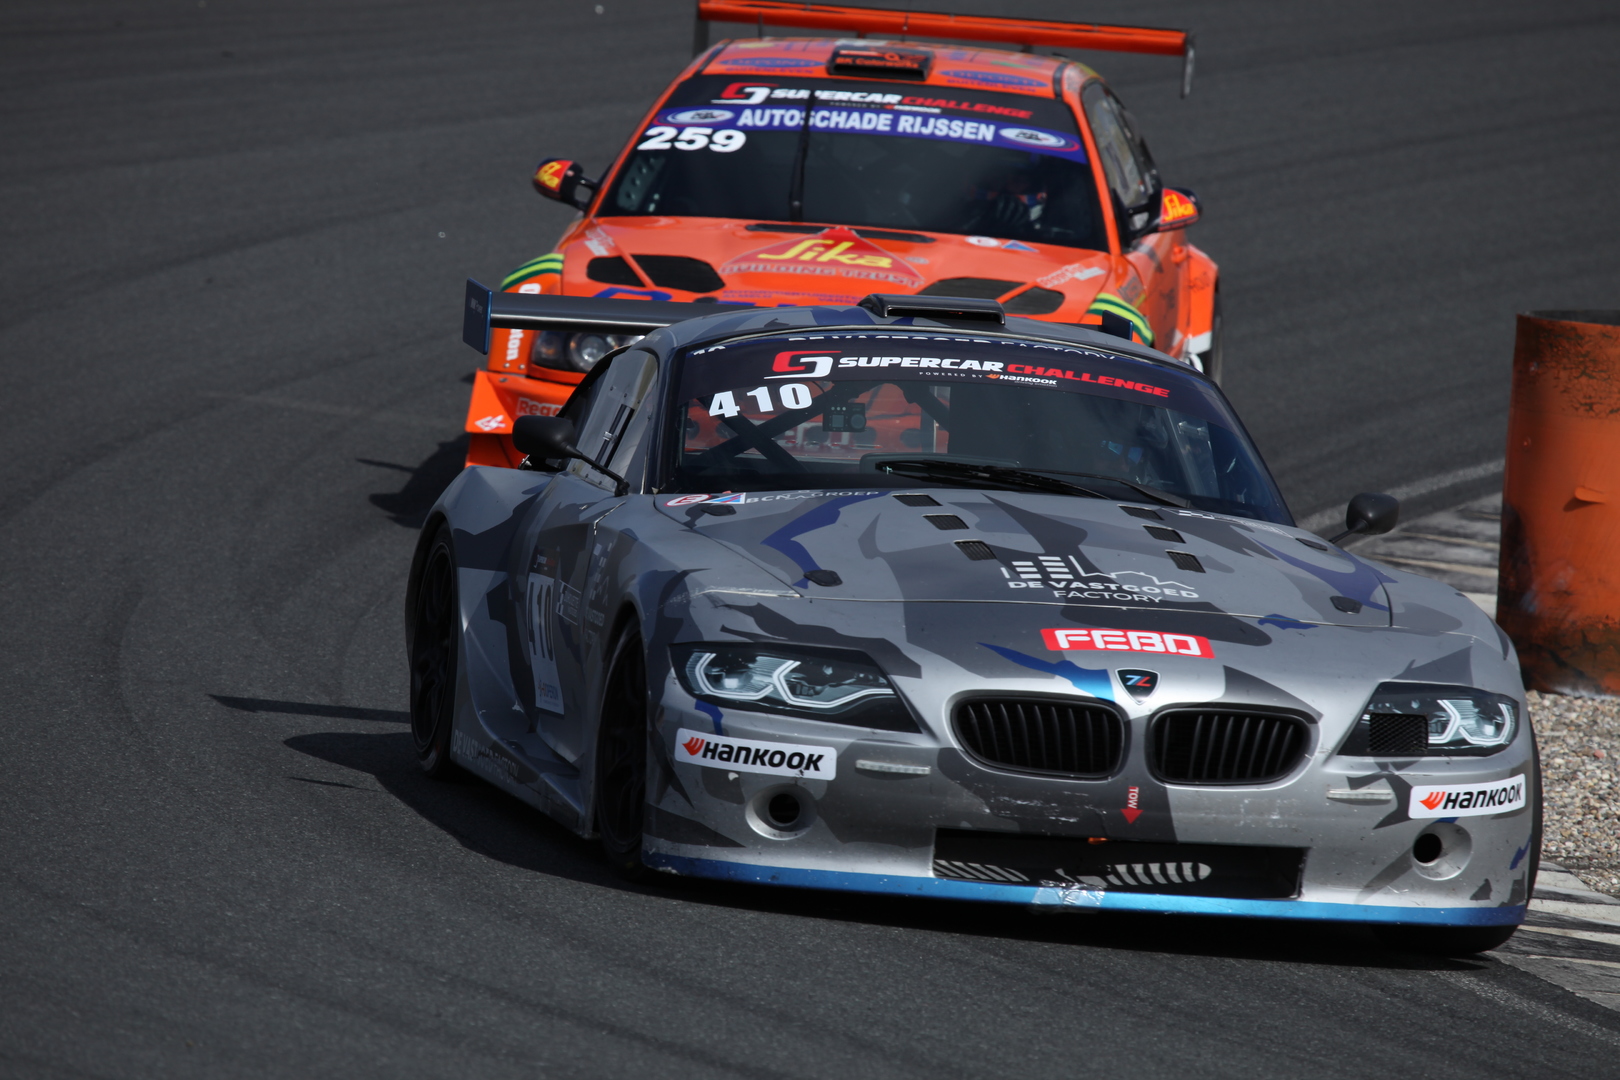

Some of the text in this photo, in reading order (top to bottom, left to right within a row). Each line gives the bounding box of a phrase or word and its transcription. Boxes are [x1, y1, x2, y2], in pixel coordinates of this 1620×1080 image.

[901, 96, 1034, 119] CHALLENGE
[637, 126, 747, 152] 259
[896, 115, 996, 142] RIJSSEN
[1162, 194, 1195, 221] Sika
[757, 239, 893, 268] Sika
[718, 263, 926, 288] BUILDING TRUST
[838, 356, 1171, 398] SUPERCAR CHALLENGE
[709, 383, 813, 418] 410
[1007, 580, 1200, 599] DE VASTGOED
[1053, 589, 1163, 604] FACTORY
[1053, 629, 1202, 656] FEBO
[1127, 787, 1140, 809] TOW
